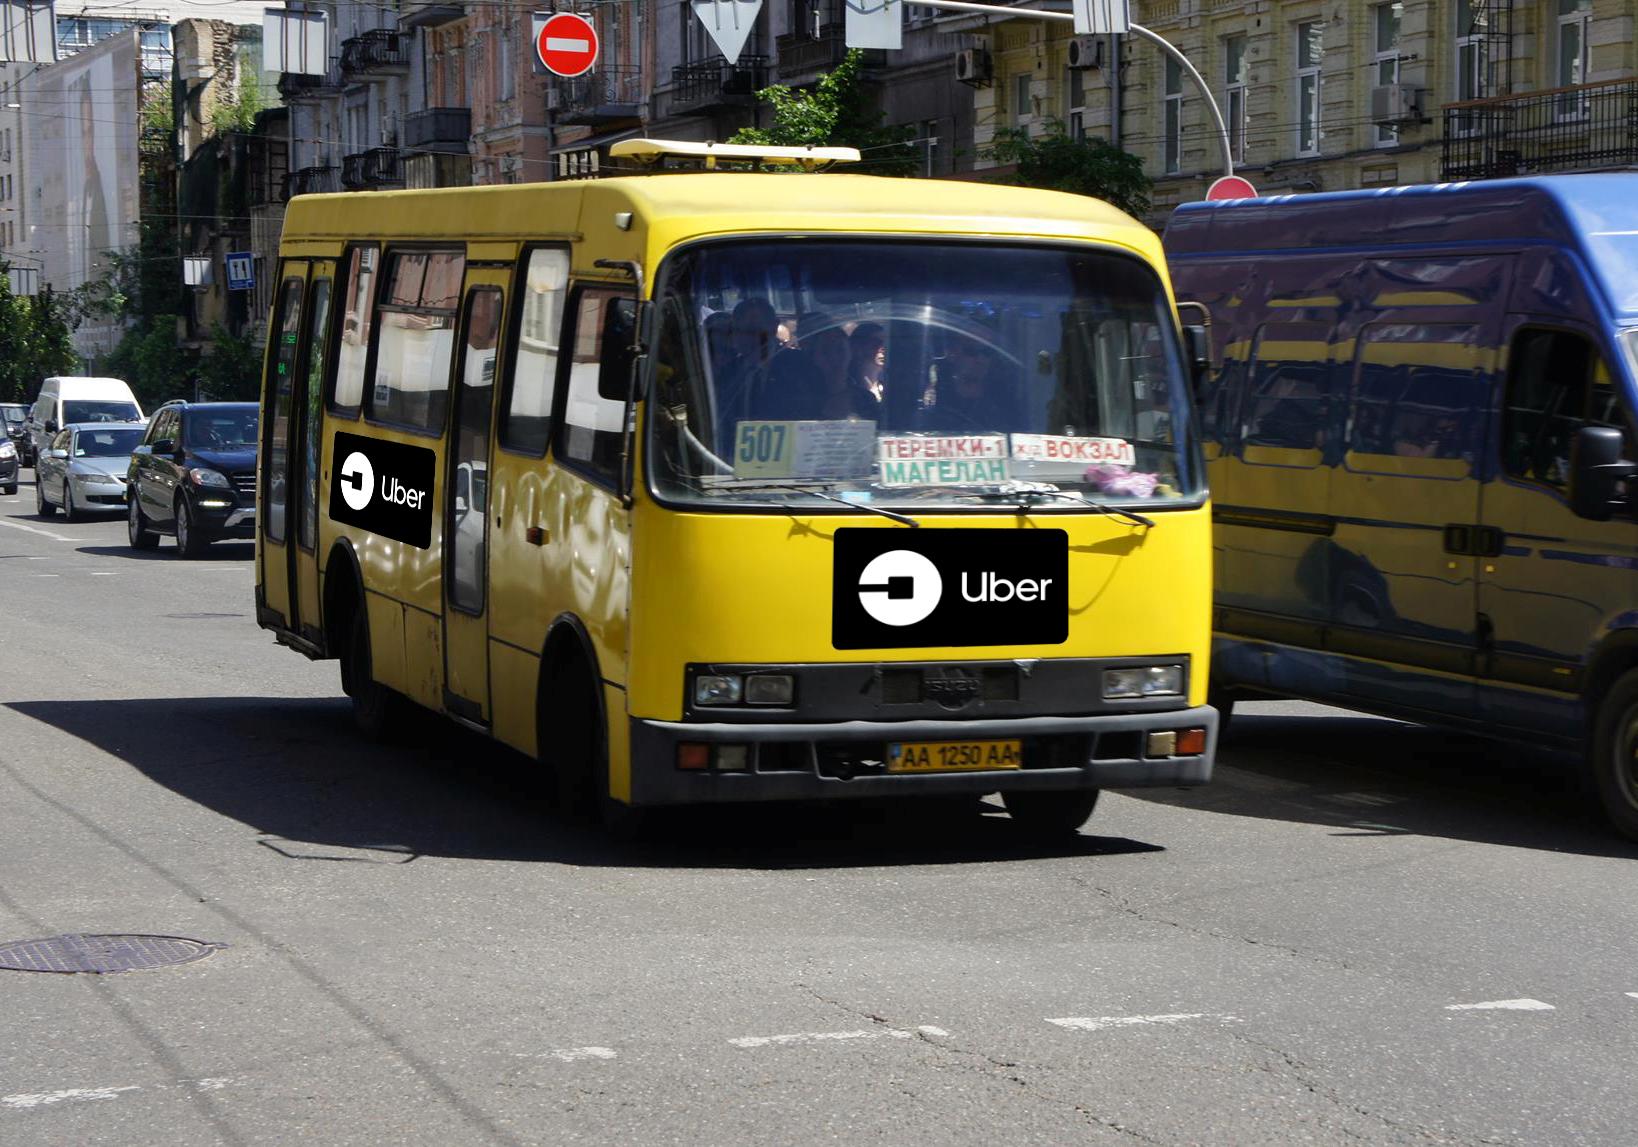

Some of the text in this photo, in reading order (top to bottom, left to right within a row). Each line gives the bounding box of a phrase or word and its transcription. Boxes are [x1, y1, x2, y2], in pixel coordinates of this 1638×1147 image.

[740, 425, 786, 463] 507
[883, 439, 1003, 458] ТЕРЕМКИ-1
[1045, 439, 1129, 459] ВОКЗАЛ
[885, 460, 1005, 483] МАГЕЛАН
[381, 475, 426, 510] Uber
[961, 571, 1053, 603] Uber
[903, 747, 930, 767] AA
[938, 745, 981, 766] 1250
